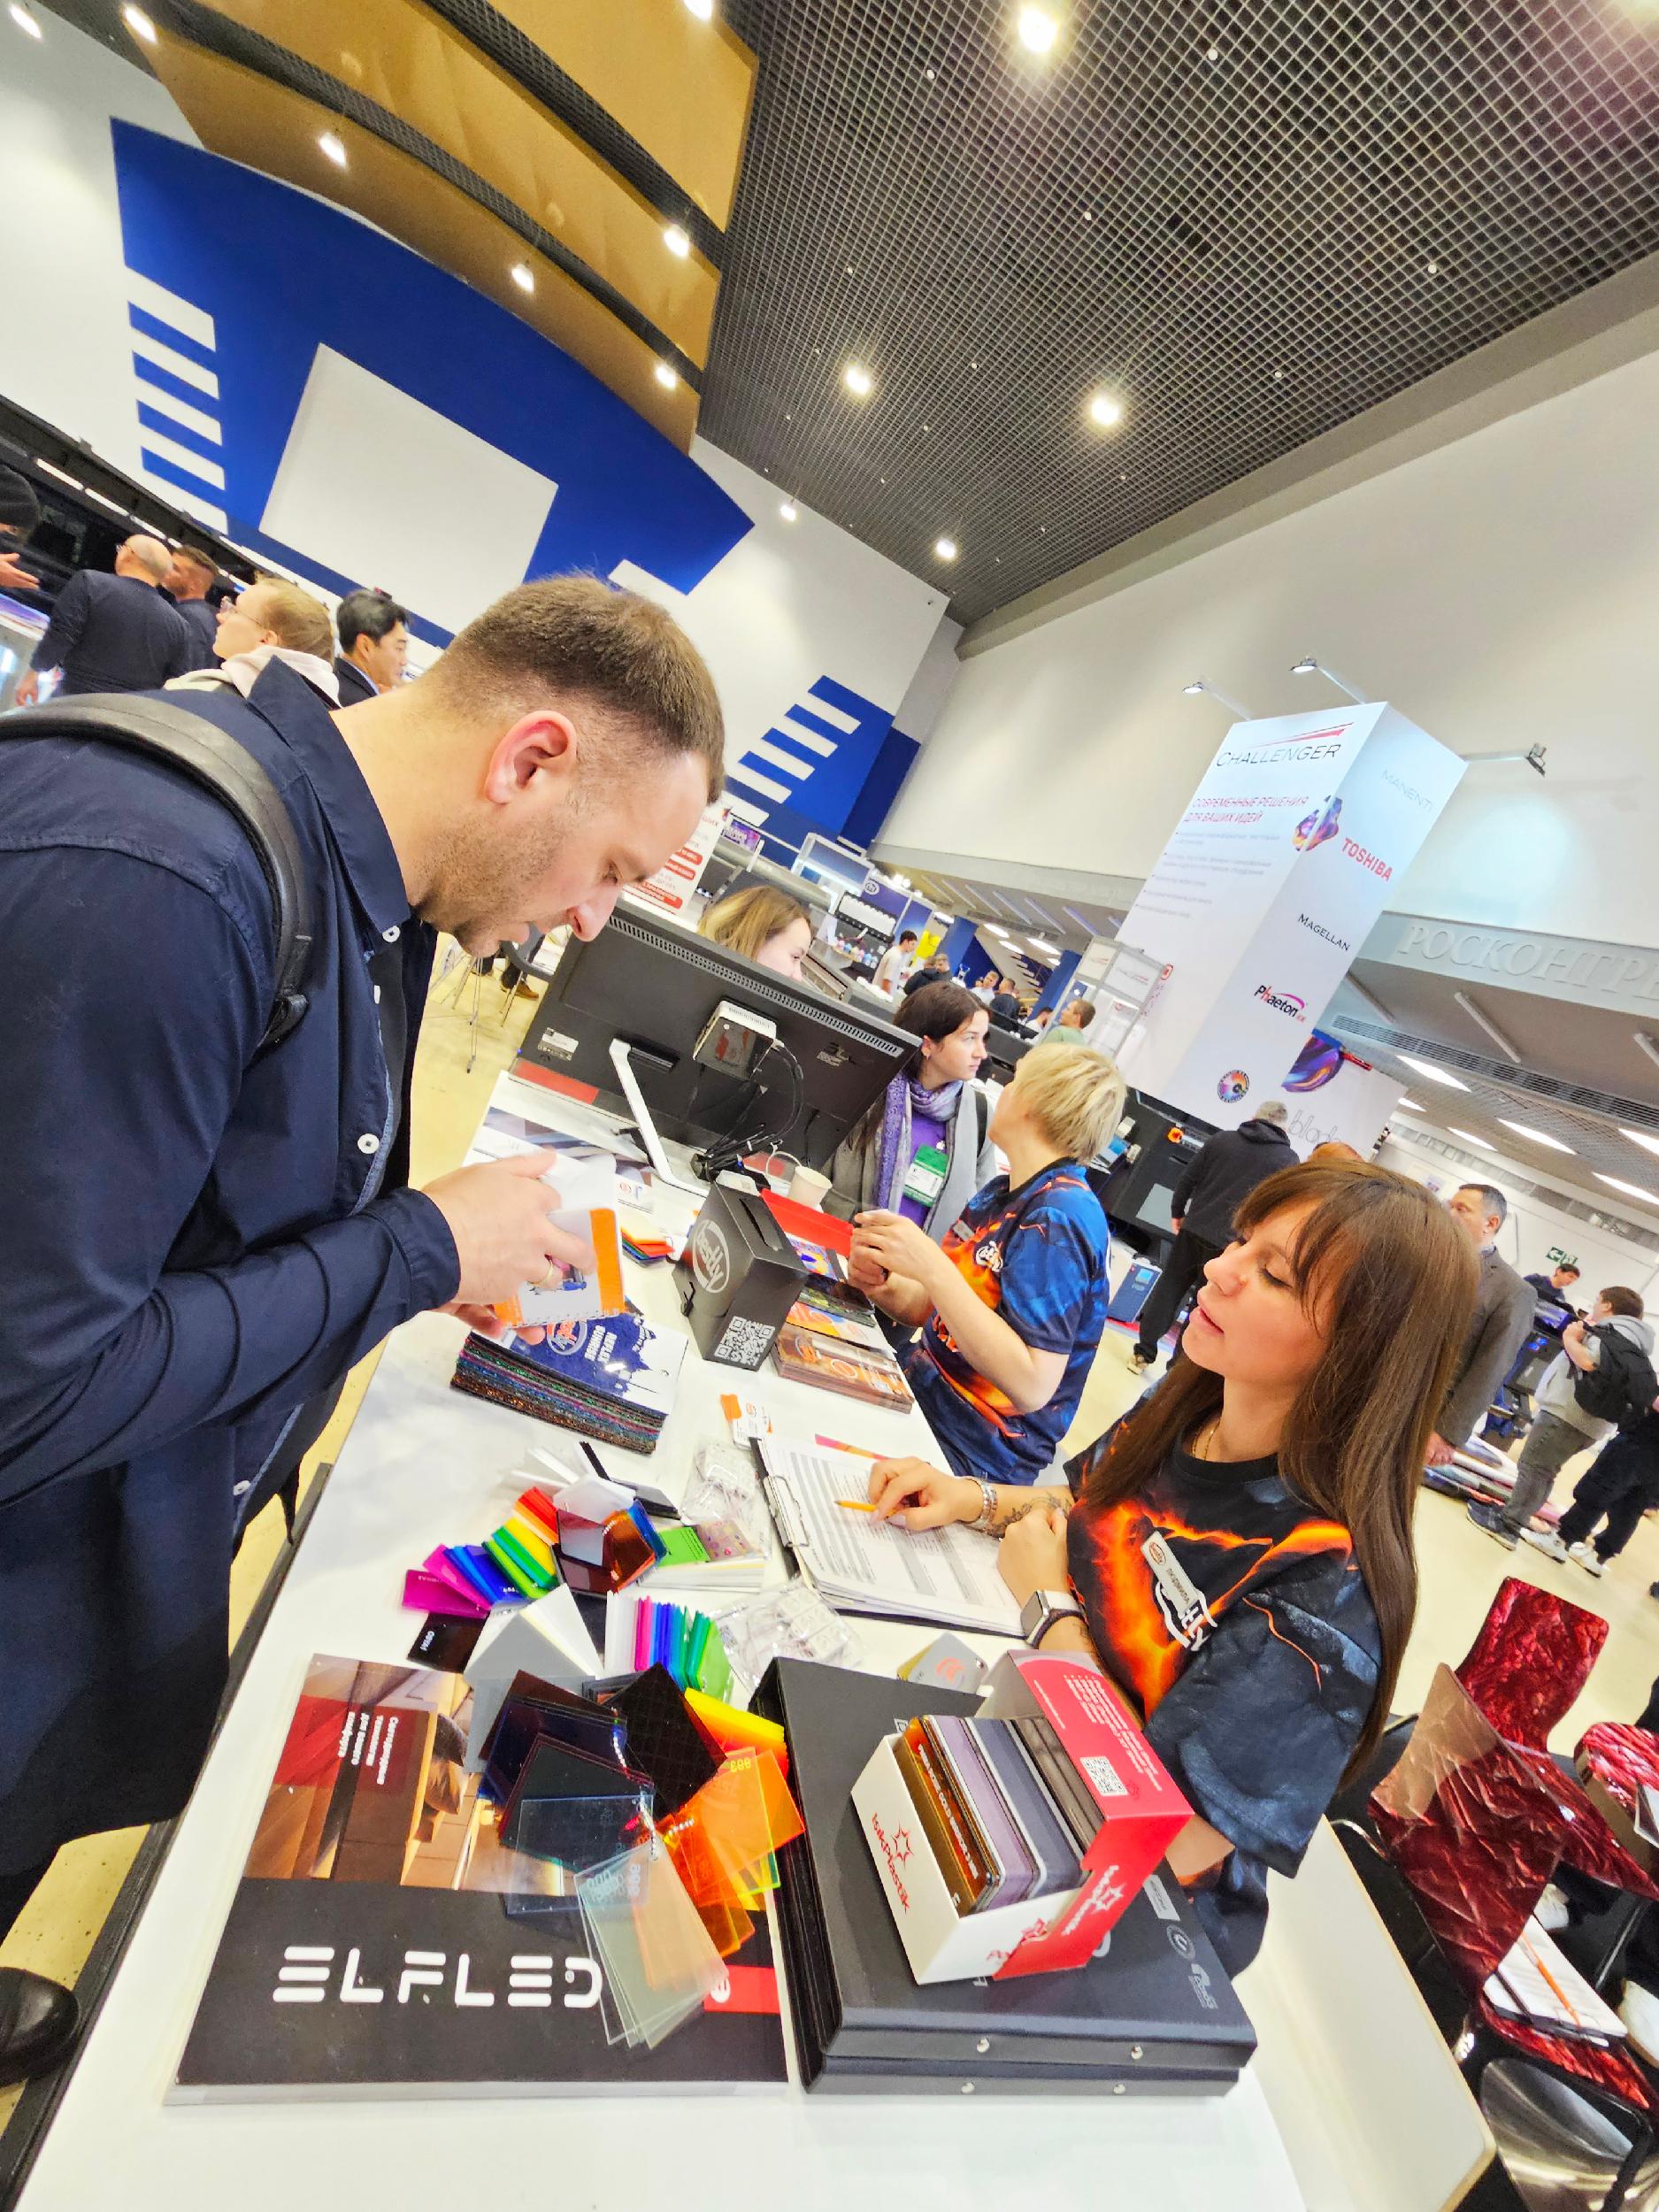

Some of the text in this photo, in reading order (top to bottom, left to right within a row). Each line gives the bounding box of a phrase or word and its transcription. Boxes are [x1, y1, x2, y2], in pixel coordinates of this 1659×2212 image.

[1217, 744, 1341, 767] CHALLENGER
[1340, 838, 1394, 882] TOSHIBA
[1297, 913, 1351, 952] MAGELLAN
[1254, 984, 1299, 1018] Phaeton
